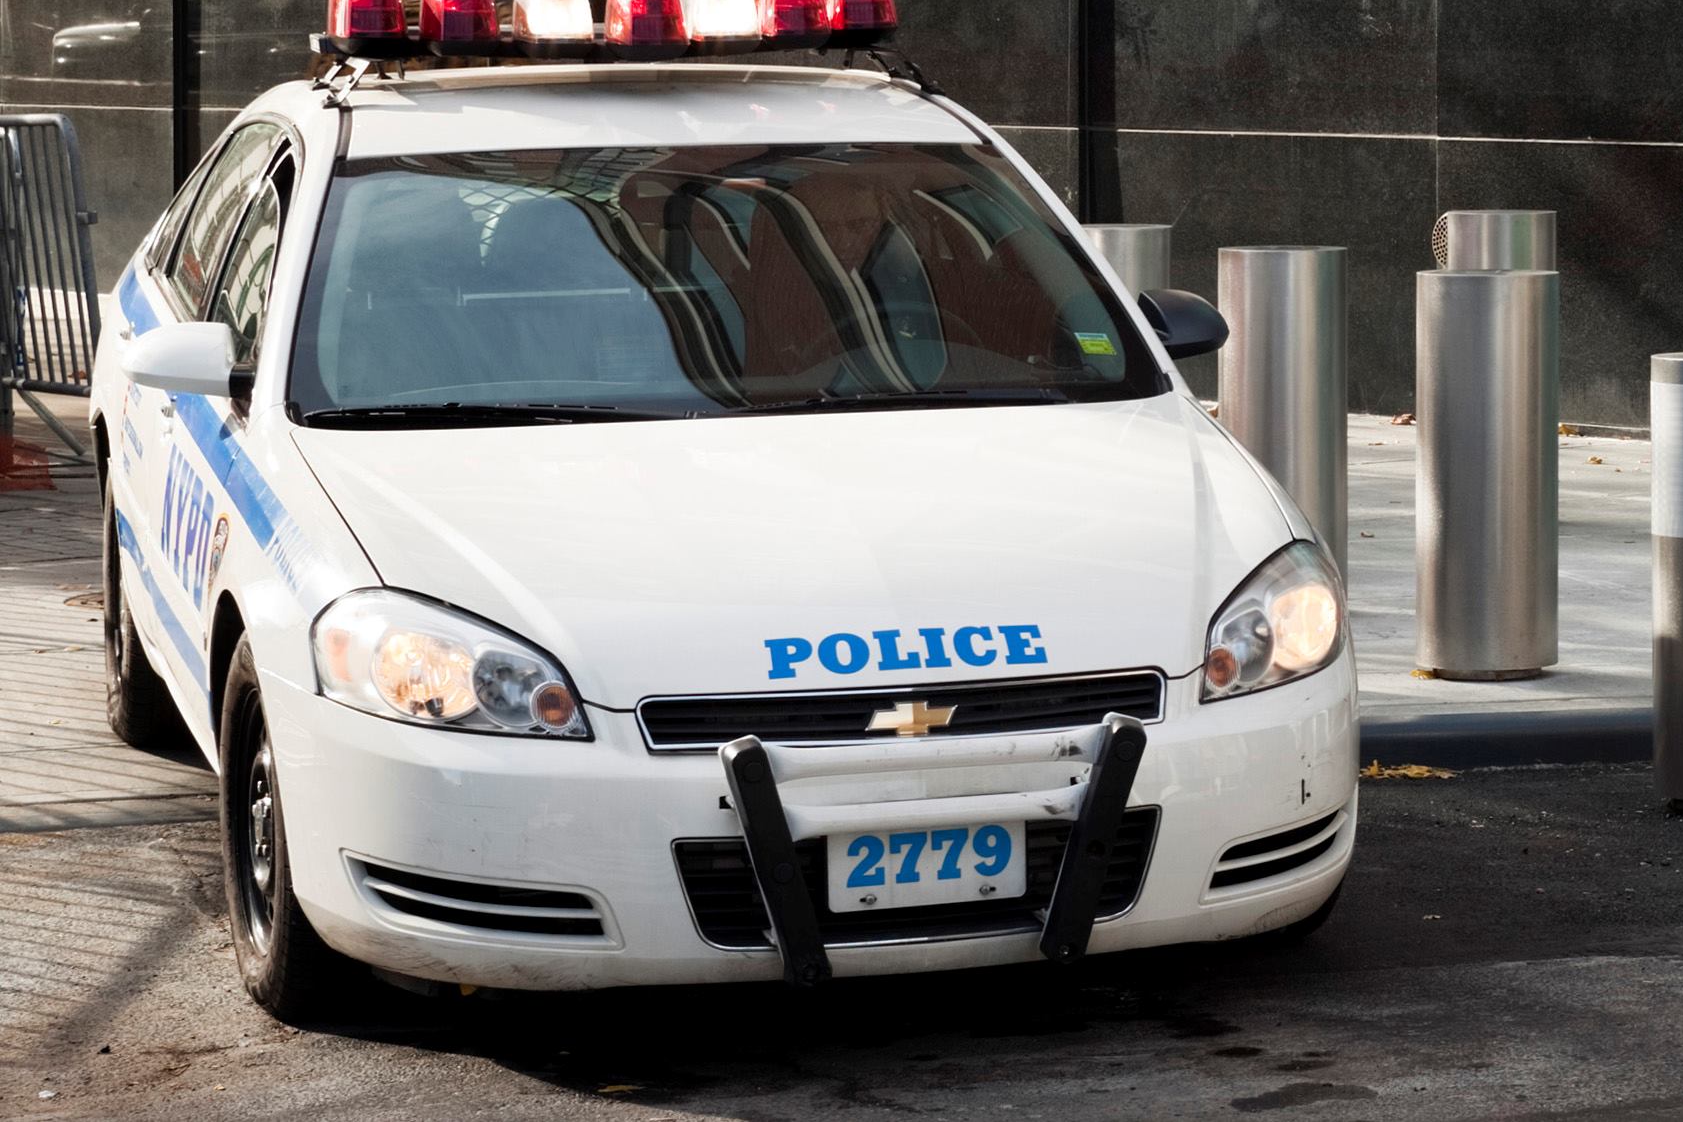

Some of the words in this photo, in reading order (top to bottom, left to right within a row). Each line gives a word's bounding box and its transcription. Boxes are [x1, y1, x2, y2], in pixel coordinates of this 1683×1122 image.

[161, 443, 214, 613] NYPD
[764, 624, 1048, 680] POLICE
[846, 824, 1012, 888] 2779
